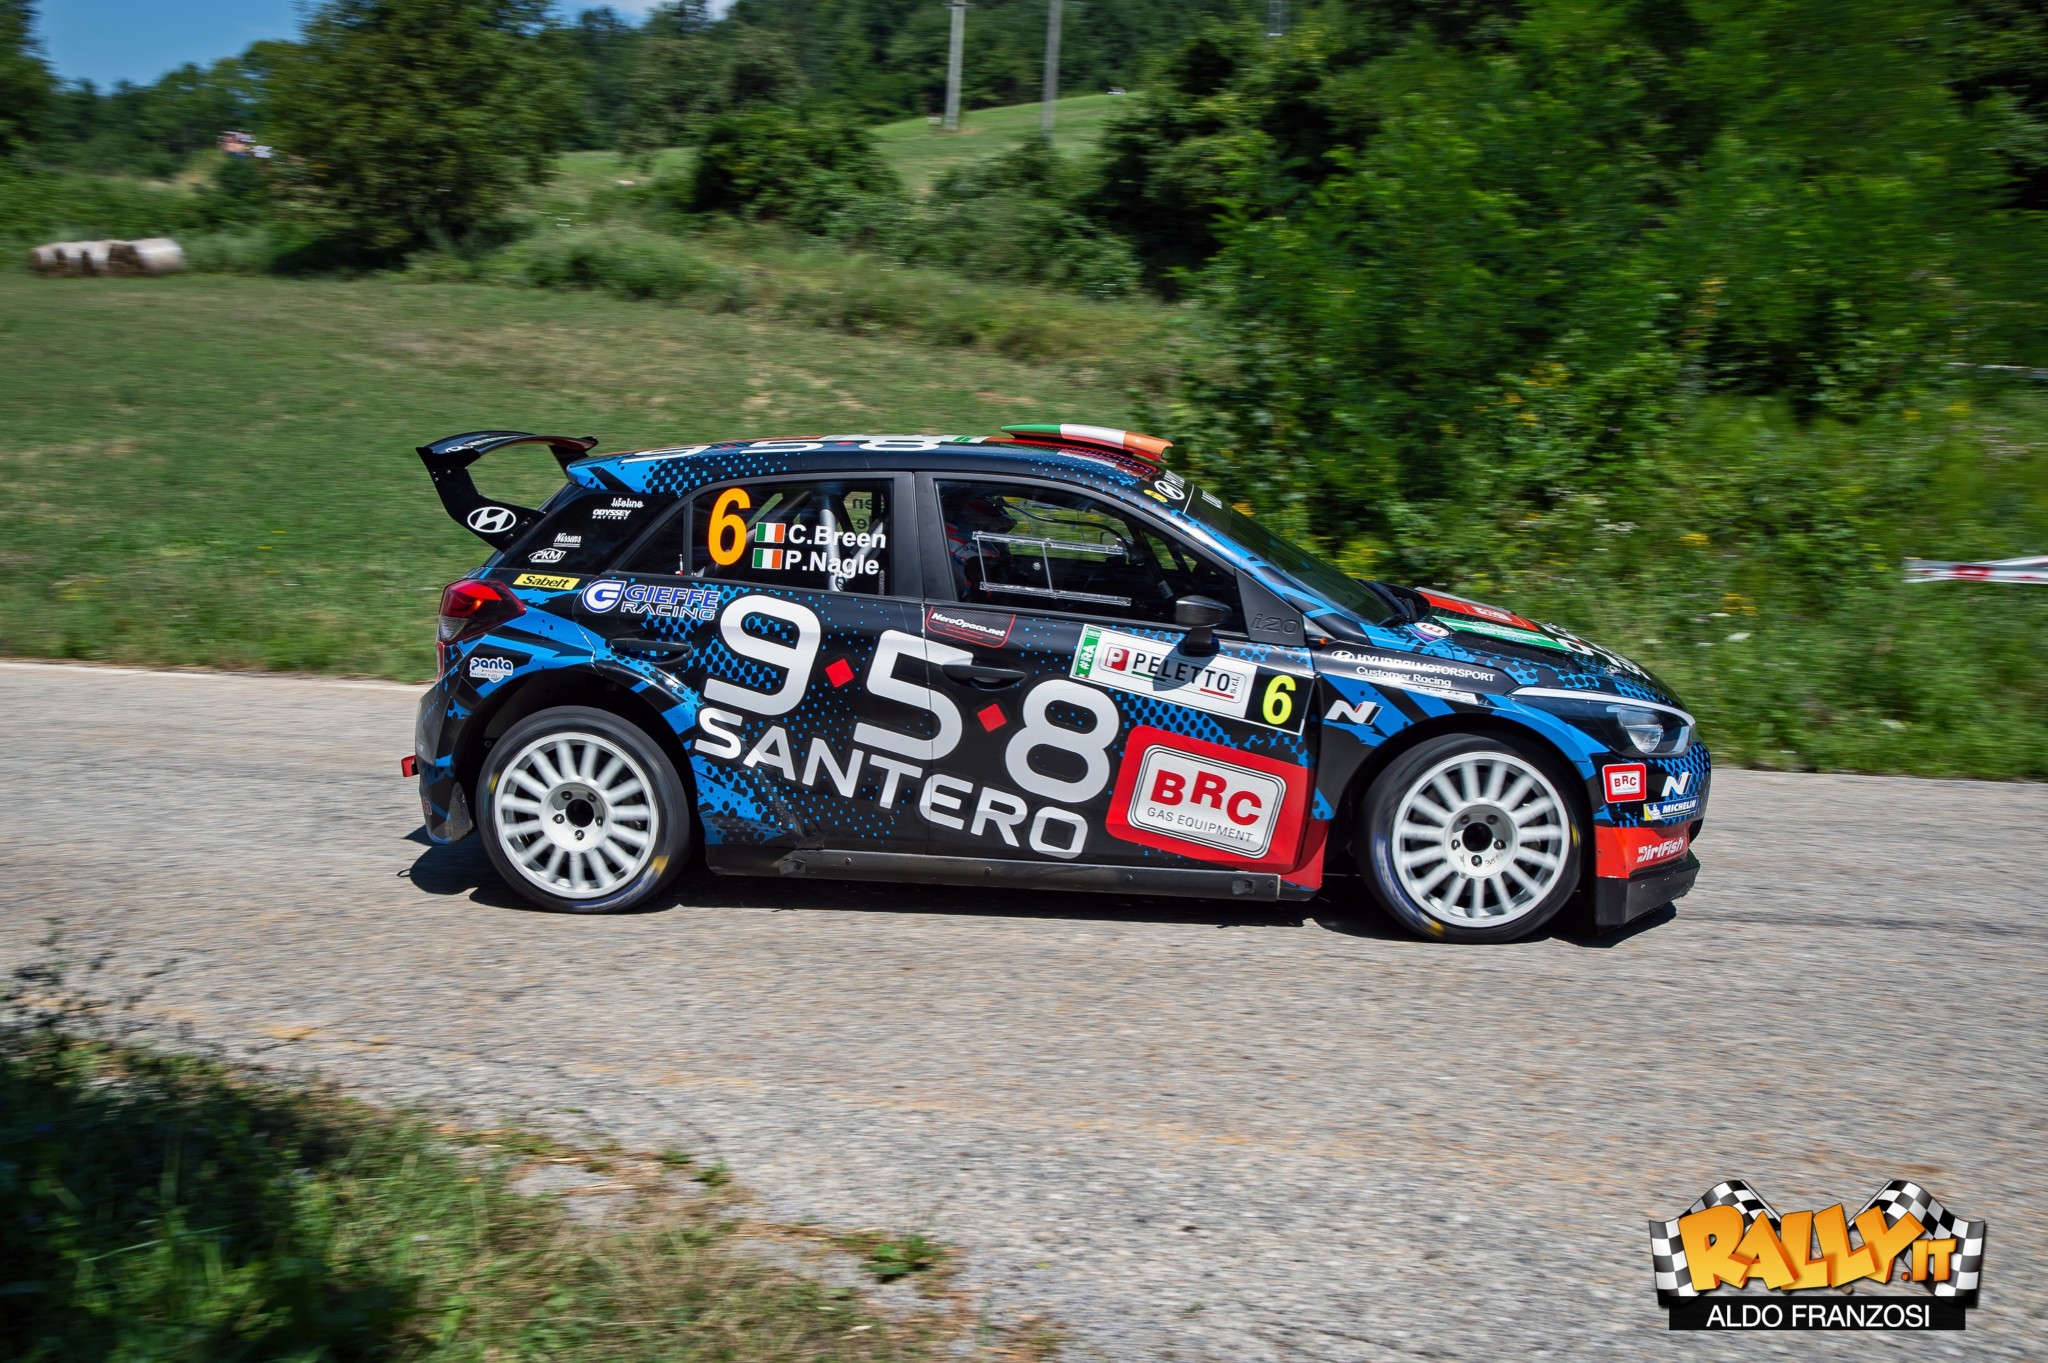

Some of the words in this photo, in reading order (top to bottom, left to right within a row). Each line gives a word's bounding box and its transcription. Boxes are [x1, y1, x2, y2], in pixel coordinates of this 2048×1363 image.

[592, 509, 631, 517] ODYSSEY
[708, 487, 751, 566] 6
[788, 524, 886, 549] C.Breen
[785, 550, 879, 579] P.Nagle
[522, 575, 569, 588] Sabelt
[624, 585, 720, 609] GIEFFE
[620, 602, 716, 621] RACING
[1251, 613, 1300, 635] i20
[471, 658, 512, 670] panta
[1133, 652, 1231, 692] PELETTO
[1356, 666, 1411, 681] Customer
[1413, 673, 1452, 688] Racing
[1263, 675, 1296, 725] 6
[694, 707, 1089, 860] SANTERO
[1613, 775, 1637, 787] BRC
[1150, 769, 1262, 826] BRC
[1662, 800, 1697, 814] MICHELIN
[1147, 807, 1174, 822] GAS
[1178, 815, 1253, 843] EQUIPMENT
